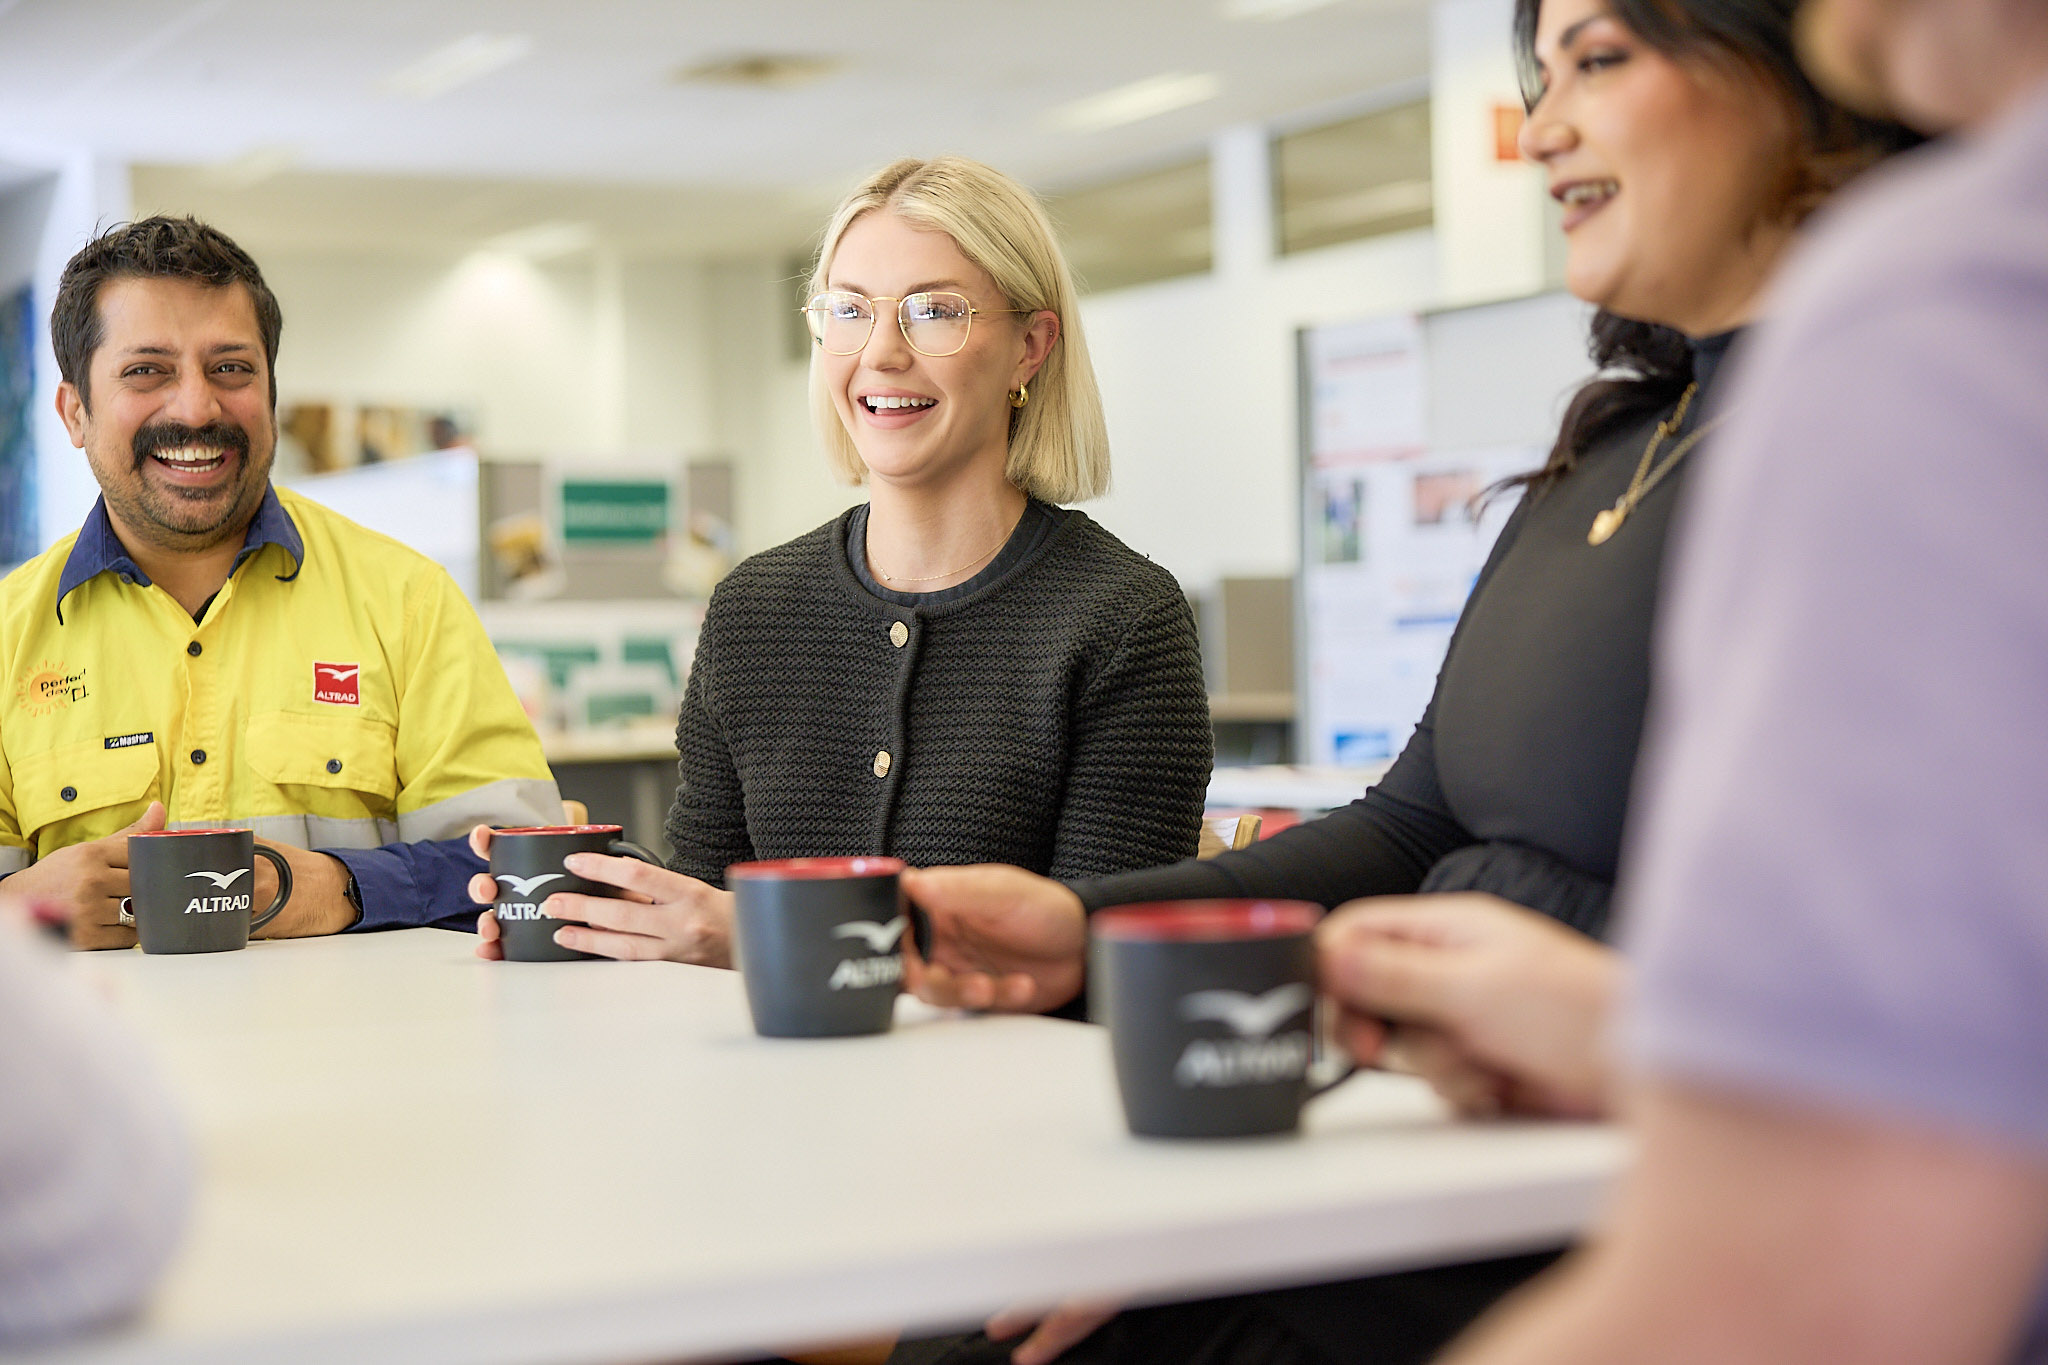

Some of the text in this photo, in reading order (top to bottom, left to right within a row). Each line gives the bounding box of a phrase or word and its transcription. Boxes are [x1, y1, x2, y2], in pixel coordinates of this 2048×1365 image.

[46, 686, 70, 698] day
[316, 690, 356, 703] ALTRAD
[184, 894, 250, 914] ALTRAD
[498, 903, 556, 920] ALTRA
